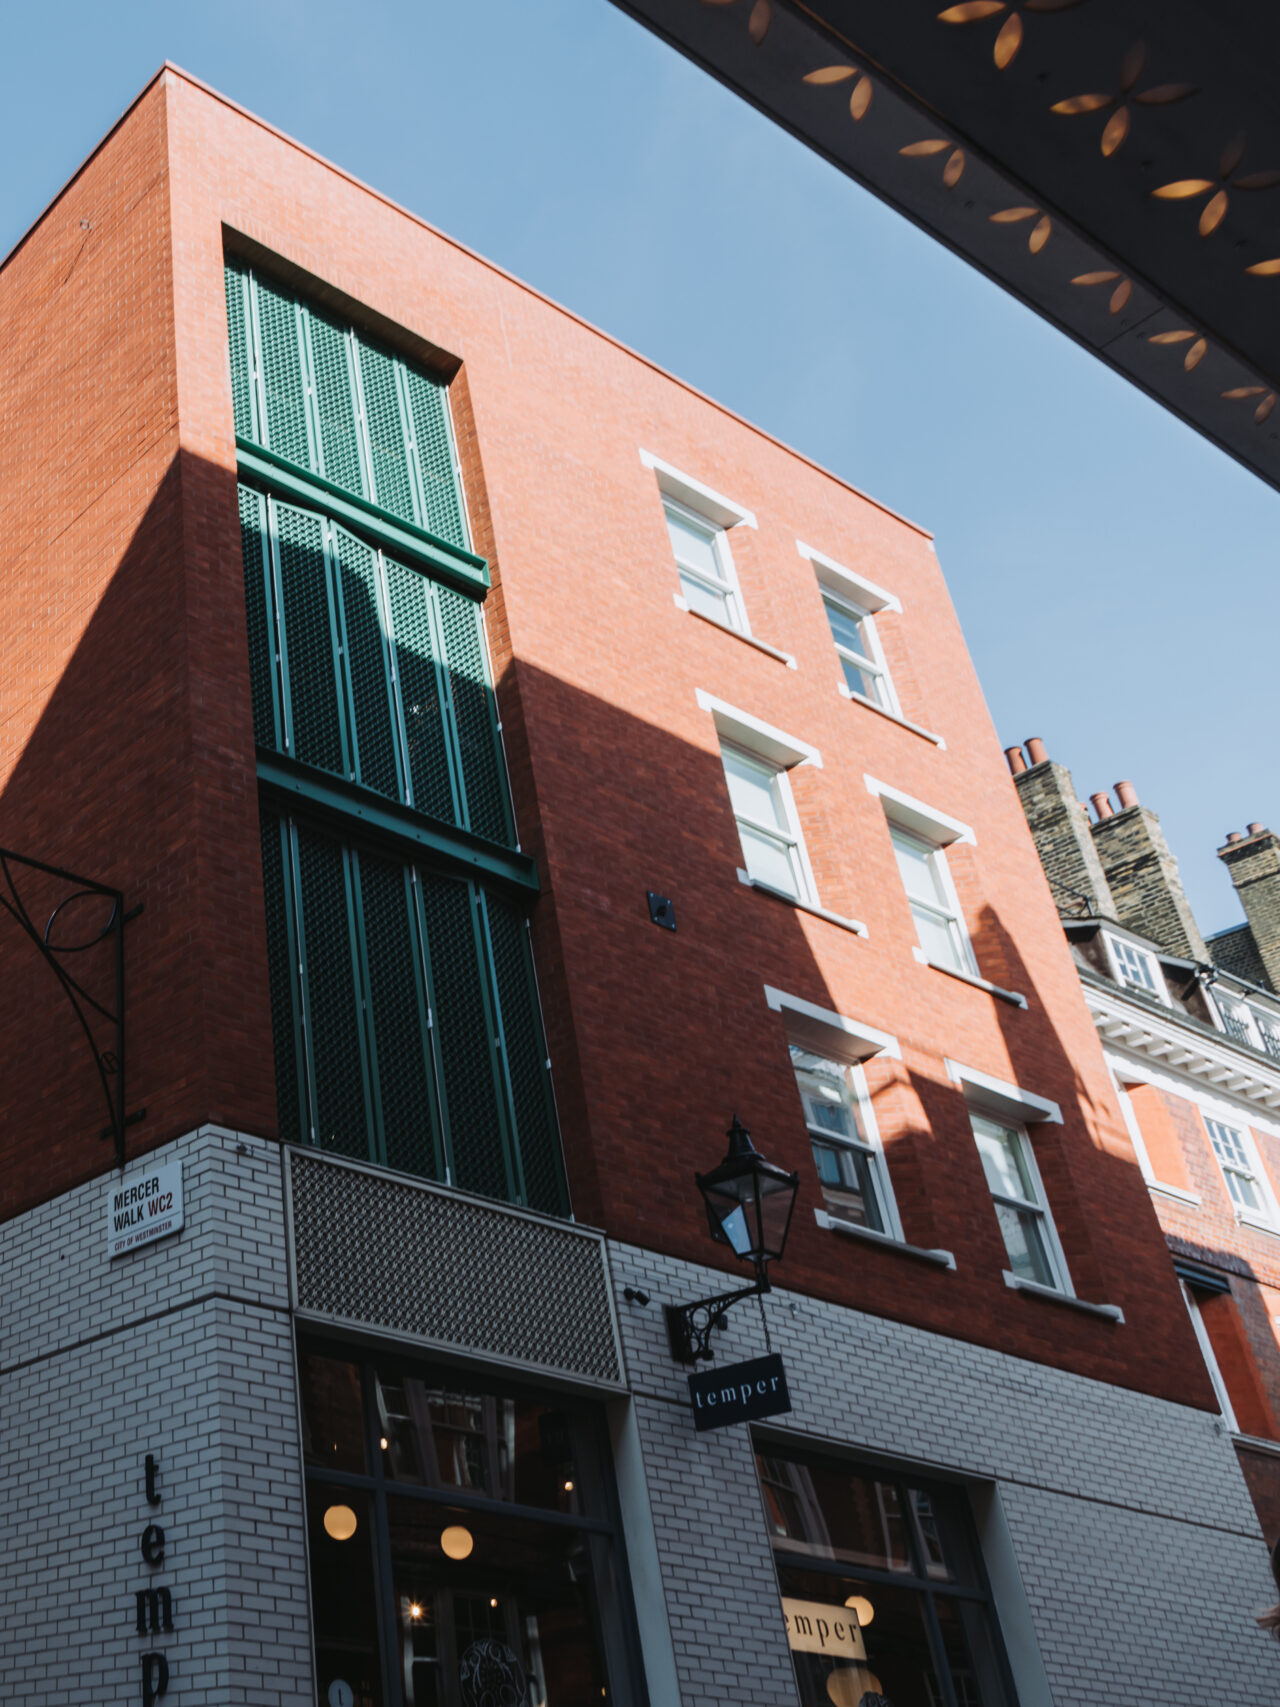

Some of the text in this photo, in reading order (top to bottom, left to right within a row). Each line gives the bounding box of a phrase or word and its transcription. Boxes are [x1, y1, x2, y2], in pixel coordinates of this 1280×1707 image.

[114, 1177, 160, 1212] MERCER
[114, 1192, 173, 1232] WALK WC2
[114, 1221, 172, 1252] CITY OF WESTMINSTER
[696, 1376, 778, 1408] temper
